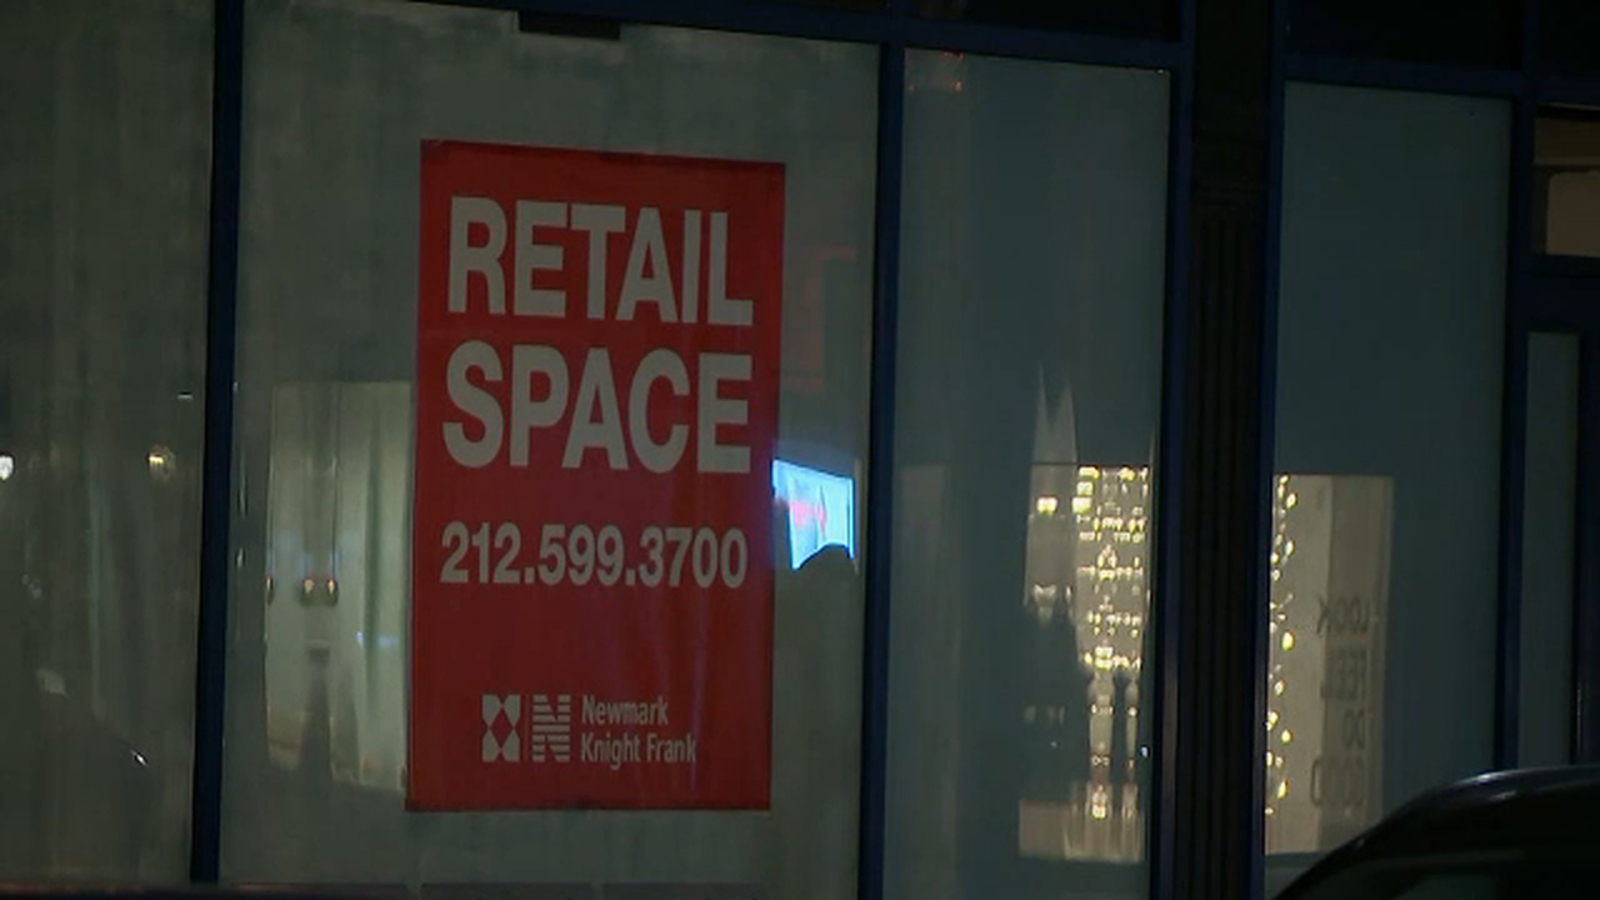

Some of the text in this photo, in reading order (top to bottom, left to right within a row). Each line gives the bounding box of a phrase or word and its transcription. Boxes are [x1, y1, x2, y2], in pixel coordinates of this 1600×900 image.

[448, 196, 753, 326] RETAIL
[443, 340, 752, 474] SPACE
[440, 521, 748, 589] 212.599.3700
[581, 694, 669, 725] Newmark
[581, 732, 697, 770] Knight Frank
